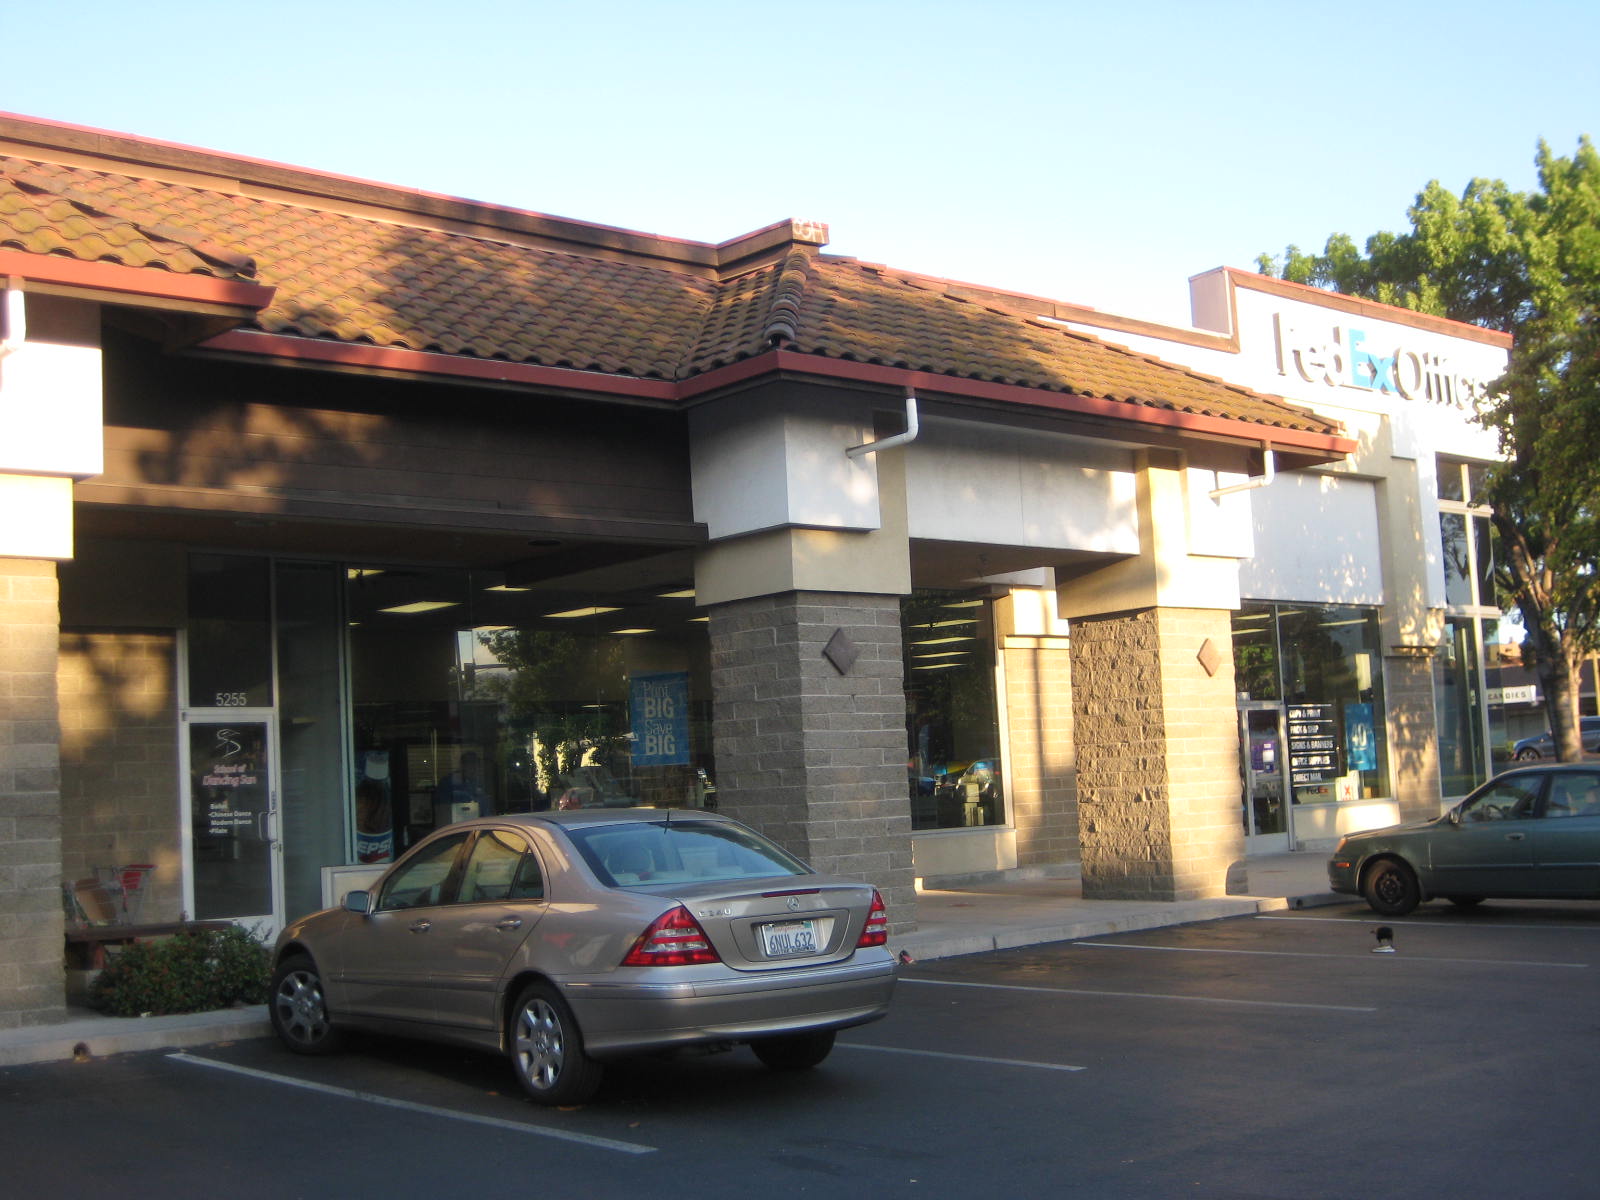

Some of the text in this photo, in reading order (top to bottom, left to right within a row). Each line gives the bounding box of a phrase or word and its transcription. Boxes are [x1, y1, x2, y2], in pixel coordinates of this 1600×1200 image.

[1272, 312, 1399, 395] FedEx
[643, 681, 670, 697] Print
[216, 692, 247, 706] 5255
[645, 698, 674, 718] BIG
[645, 720, 673, 735] Save
[646, 735, 675, 755] BIG
[1310, 740, 1334, 749] BANNERS
[202, 775, 239, 787] Dancing
[770, 931, 813, 952] 6NUL632
